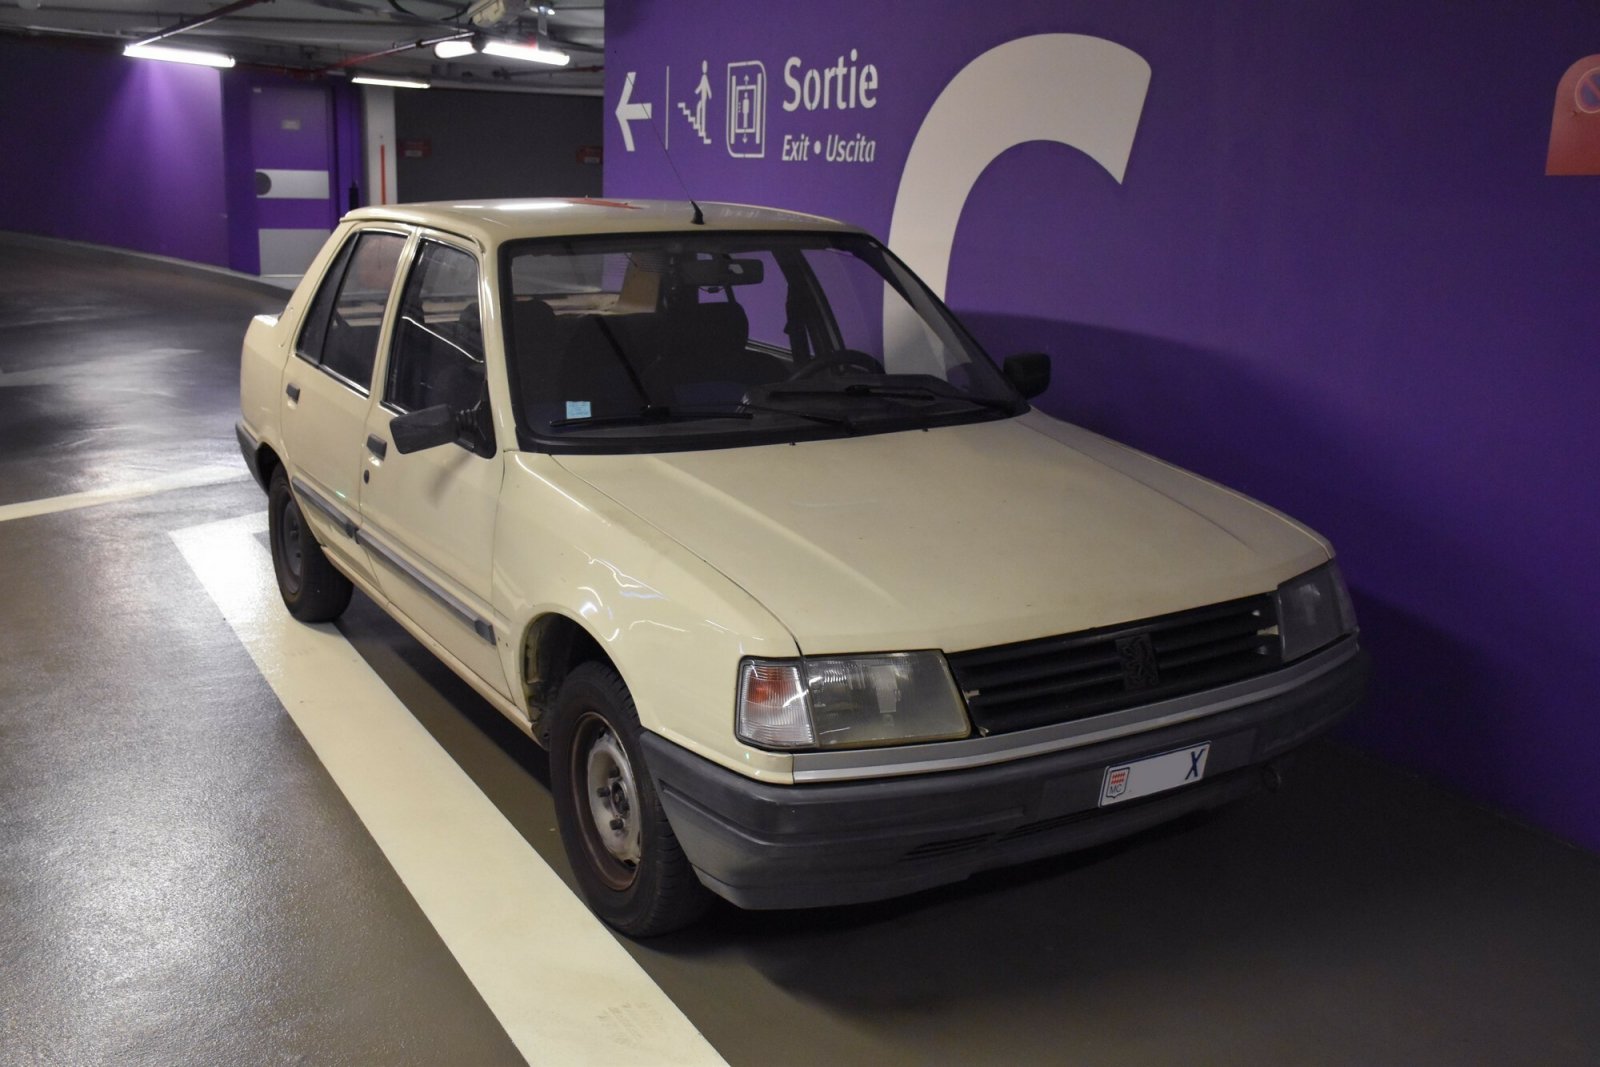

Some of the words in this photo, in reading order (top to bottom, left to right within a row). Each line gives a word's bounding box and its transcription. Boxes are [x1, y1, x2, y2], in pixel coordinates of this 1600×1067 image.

[782, 48, 878, 112] Sortie
[782, 133, 809, 161] Exit
[826, 133, 876, 162] Uscita
[1184, 748, 1206, 780] X
